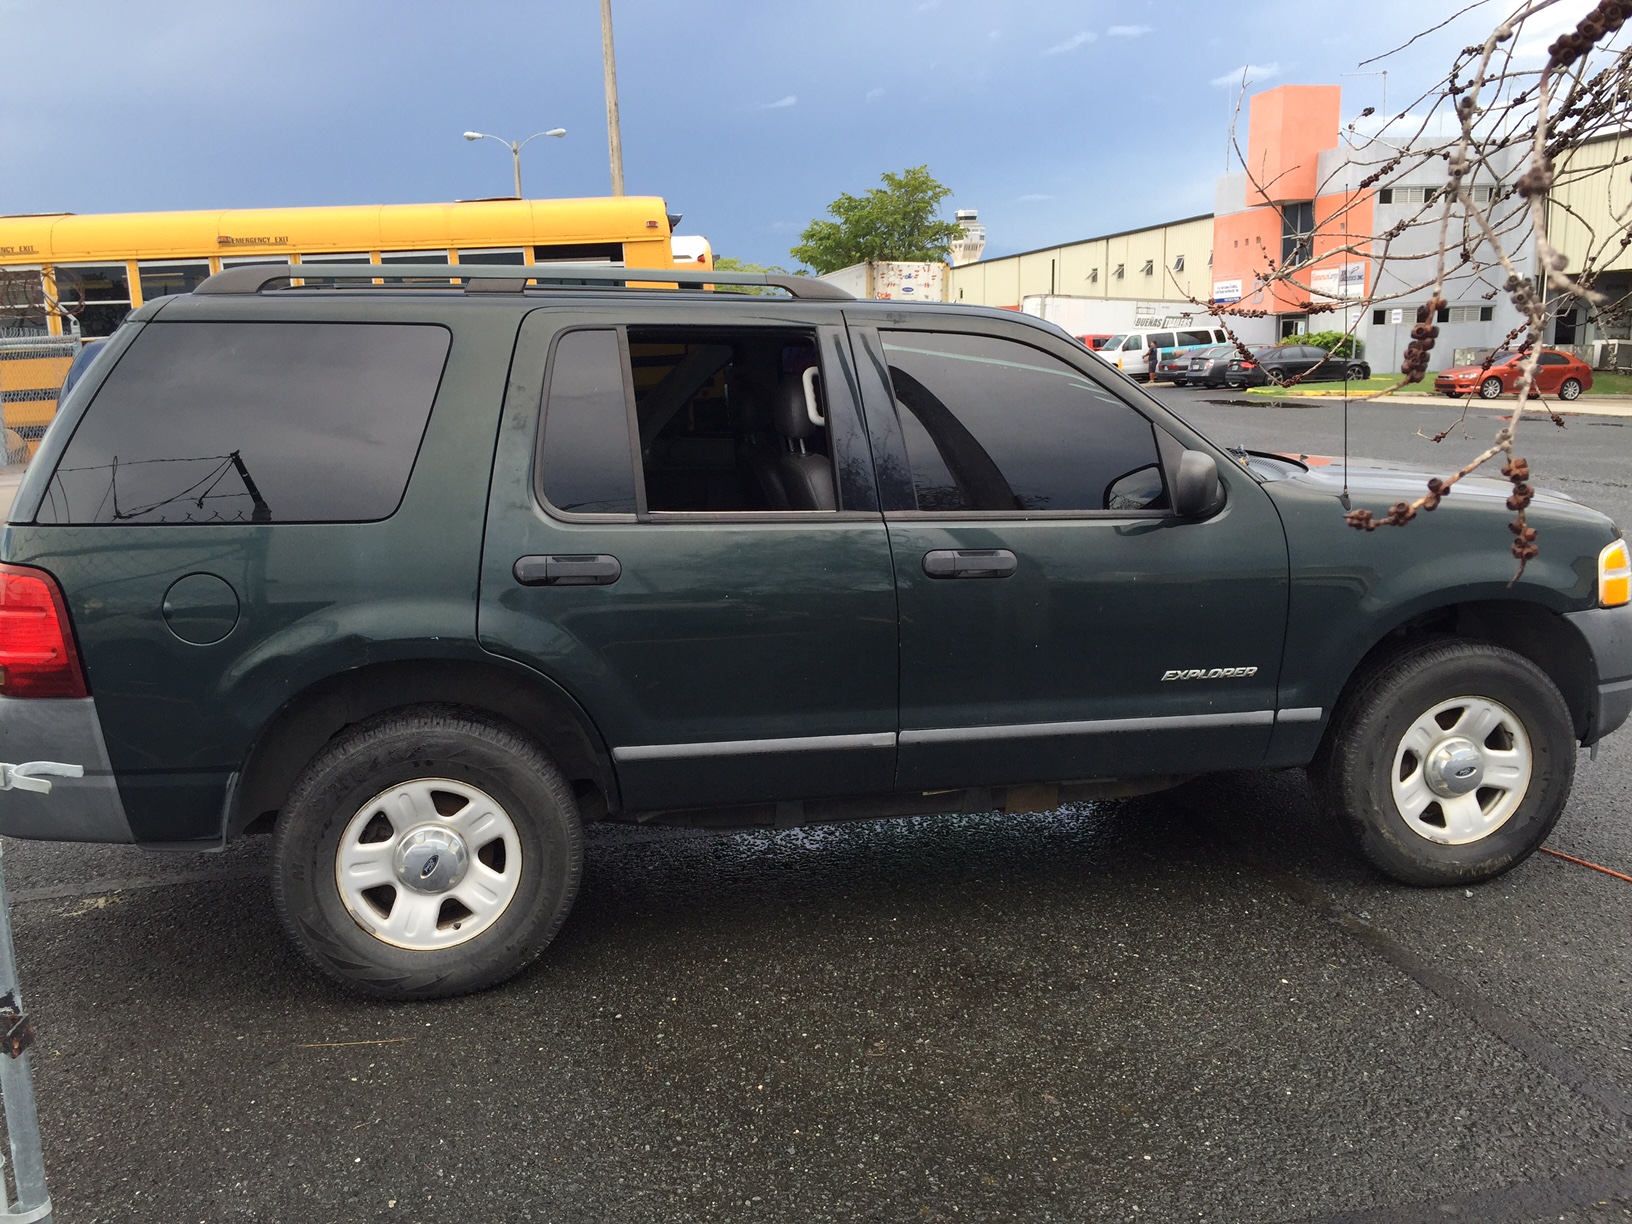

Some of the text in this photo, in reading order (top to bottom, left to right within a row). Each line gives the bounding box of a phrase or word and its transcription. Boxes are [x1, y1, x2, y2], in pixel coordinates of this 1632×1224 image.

[231, 235, 289, 245] EMERGENCY EXIT
[1134, 316, 1163, 328] DUEÑAS
[1160, 666, 1259, 682] EXPLORER
